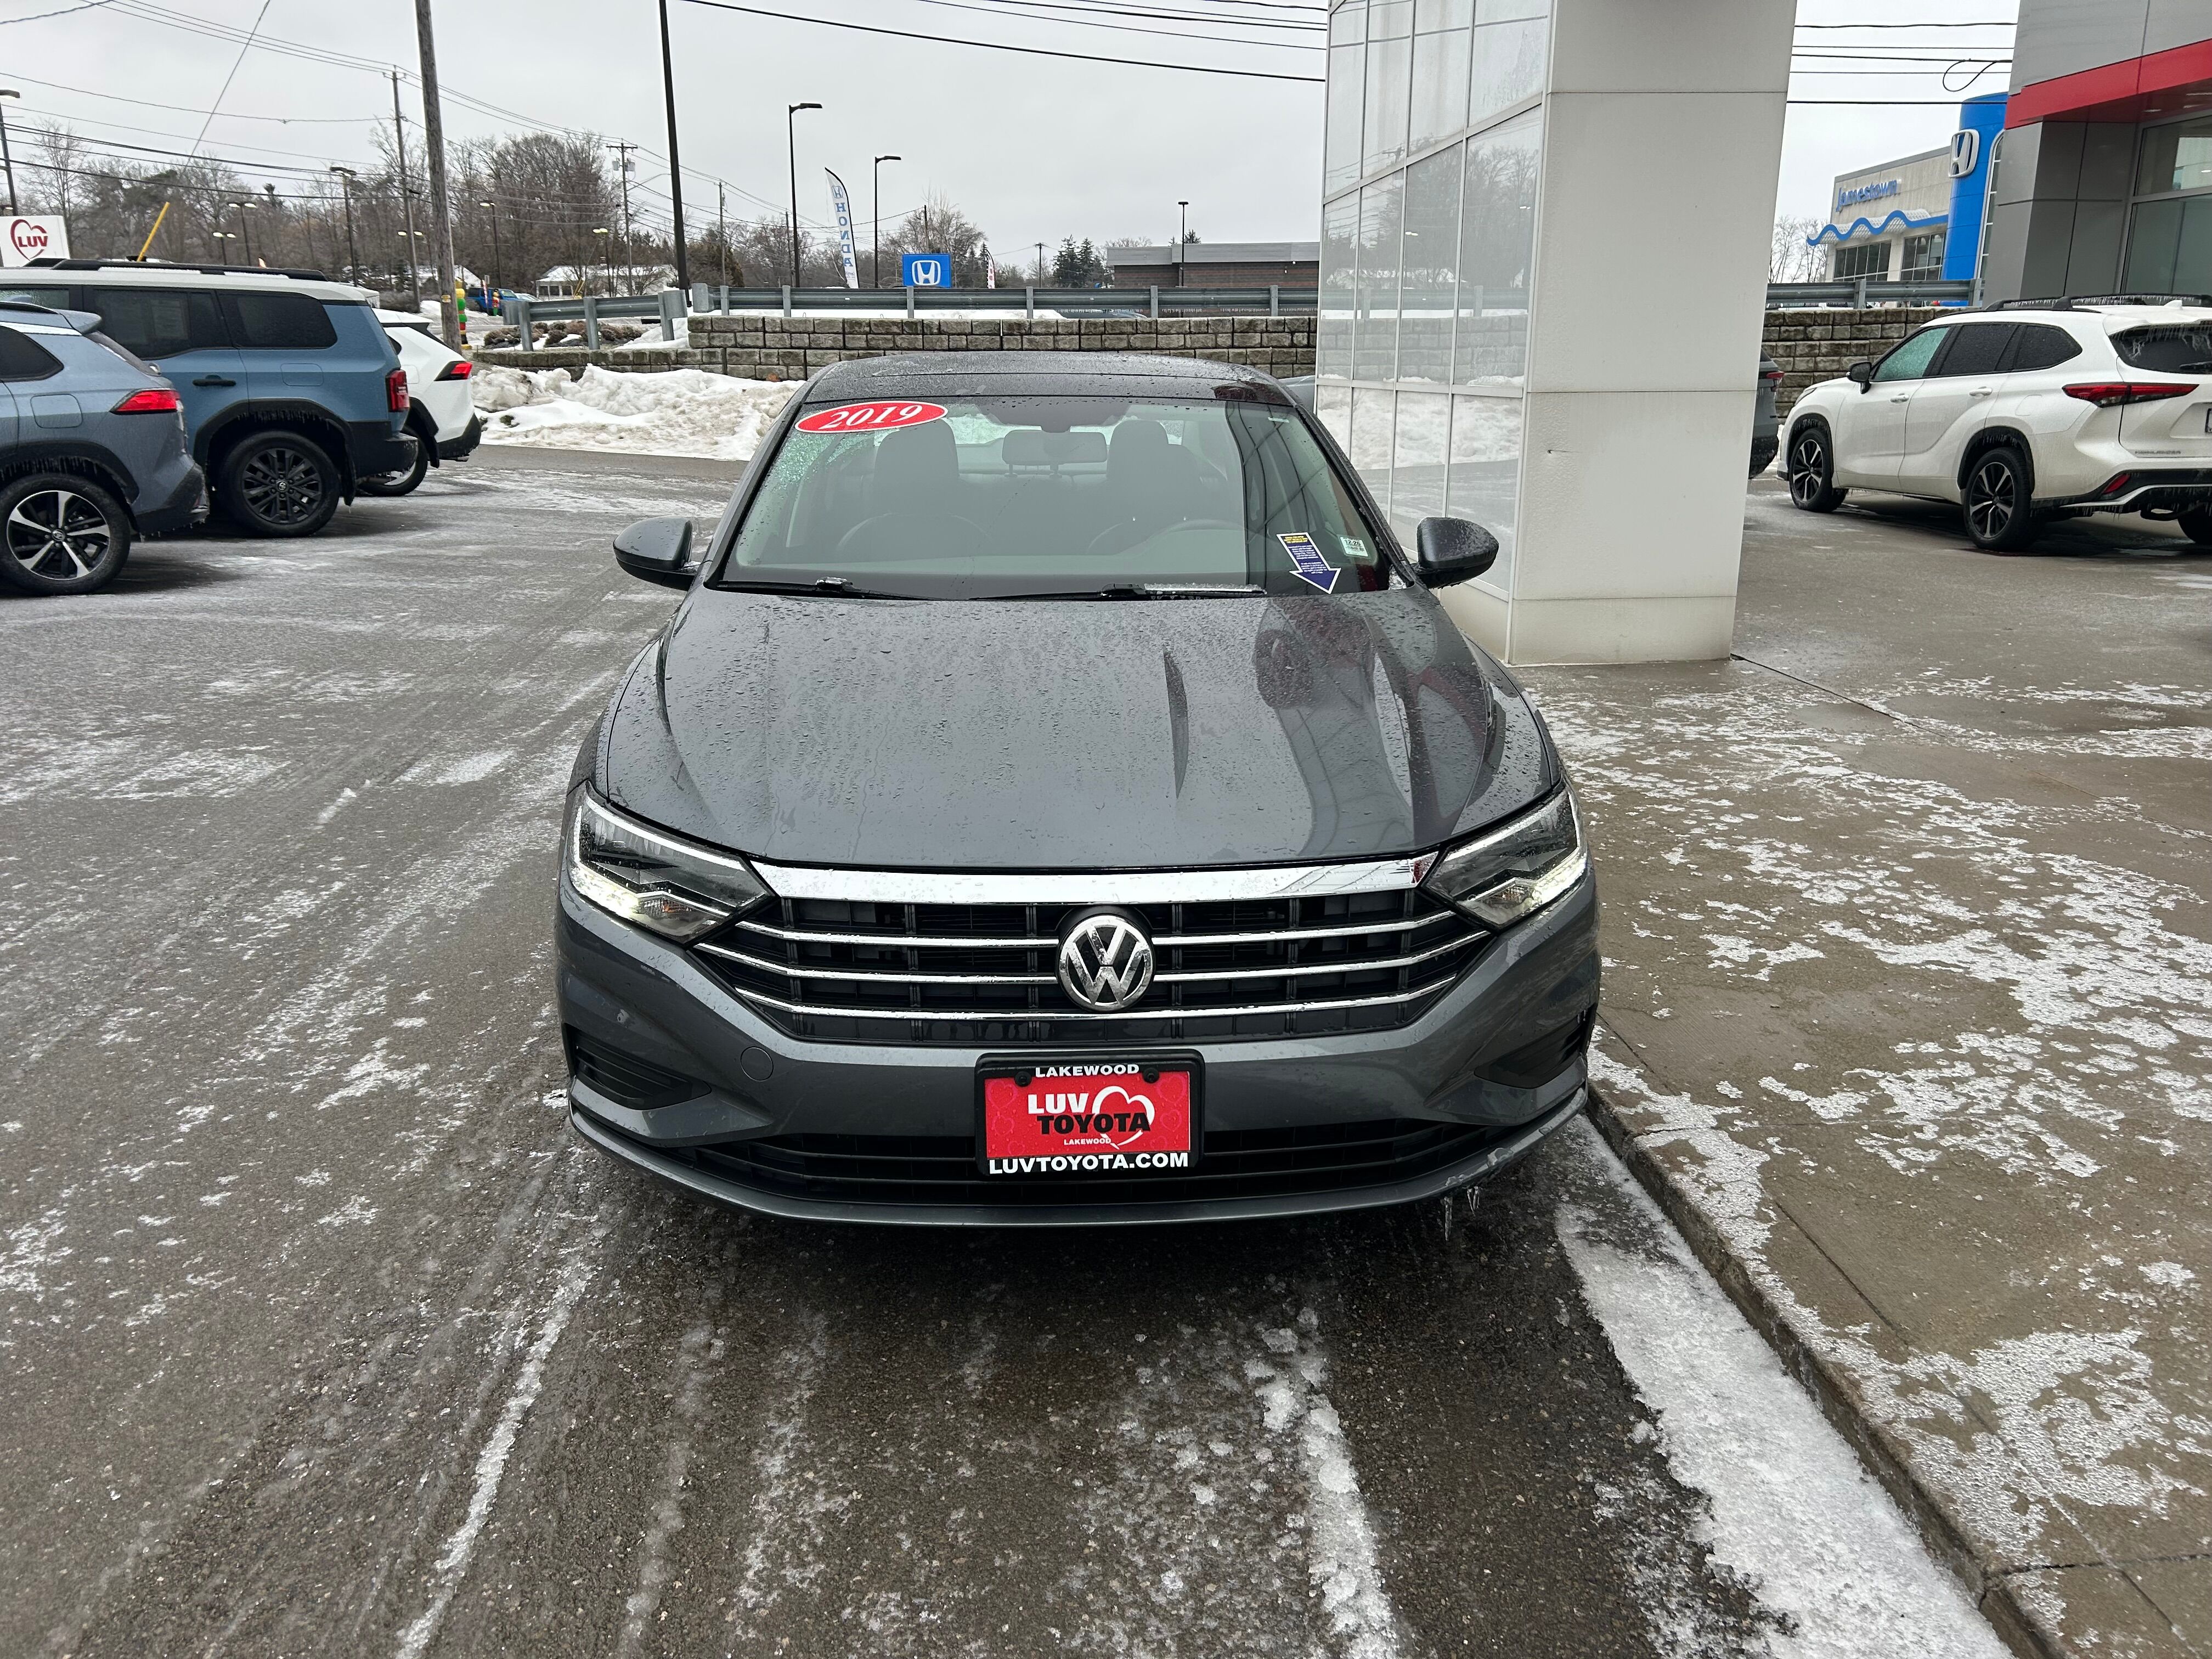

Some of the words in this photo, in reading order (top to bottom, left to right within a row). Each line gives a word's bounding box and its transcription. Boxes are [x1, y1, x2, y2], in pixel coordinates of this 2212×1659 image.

[1836, 180, 1899, 212] Jamestown
[18, 236, 48, 247] LUV
[818, 405, 923, 430] 2019
[1035, 1064, 1139, 1077] LAKEWOOD
[1028, 1093, 1089, 1114] LUV
[1037, 1112, 1150, 1134] TOYOTA
[1064, 1137, 1111, 1146] LAKEWOOD
[989, 1152, 1188, 1174] LUVTOYOTA.COM
